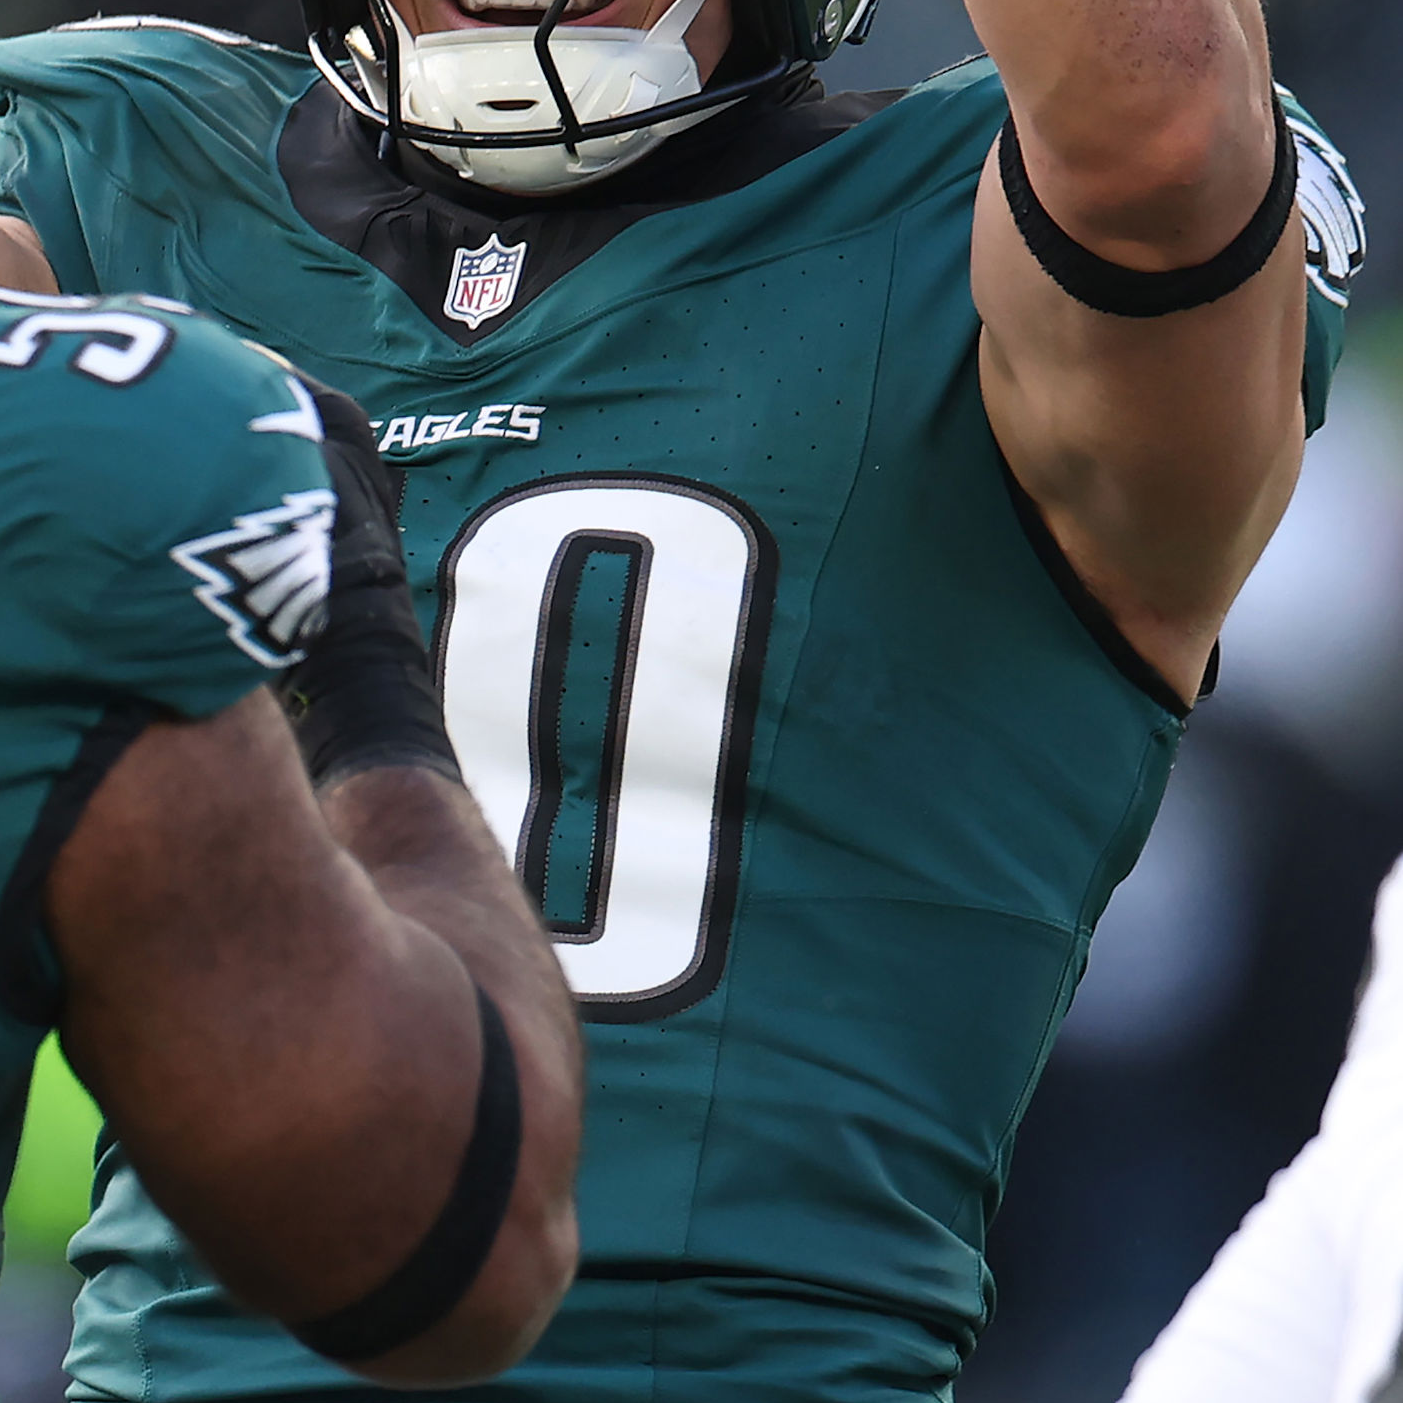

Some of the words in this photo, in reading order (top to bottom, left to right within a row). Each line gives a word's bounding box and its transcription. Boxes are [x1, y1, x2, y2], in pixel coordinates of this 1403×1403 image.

[458, 277, 504, 311] NFL
[369, 403, 547, 453] AGLES
[398, 470, 781, 1024] 0
